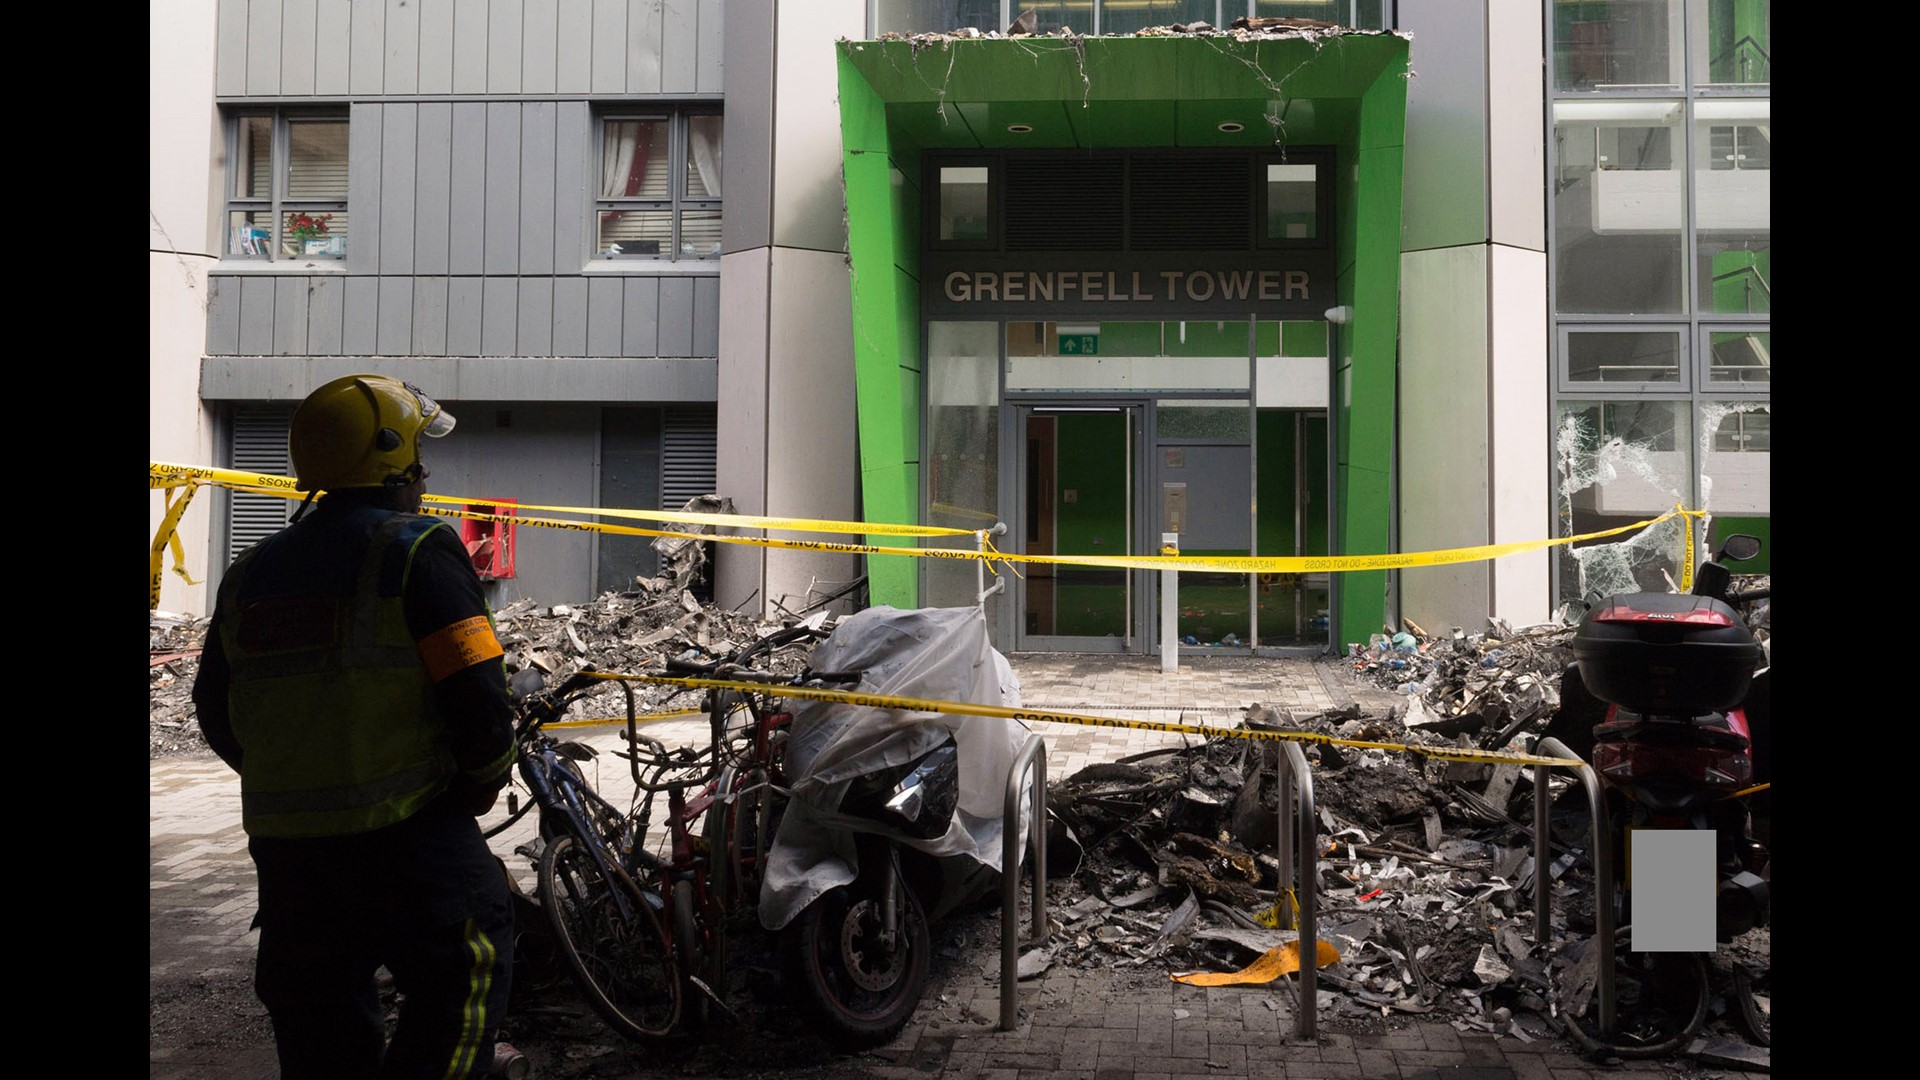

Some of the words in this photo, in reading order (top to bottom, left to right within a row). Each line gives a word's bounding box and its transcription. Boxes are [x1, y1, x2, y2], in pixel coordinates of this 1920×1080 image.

[943, 270, 1153, 302] GRENFELL
[1160, 270, 1310, 301] TOWER
[1684, 565, 1691, 577] DO
[448, 620, 474, 633] INNER
